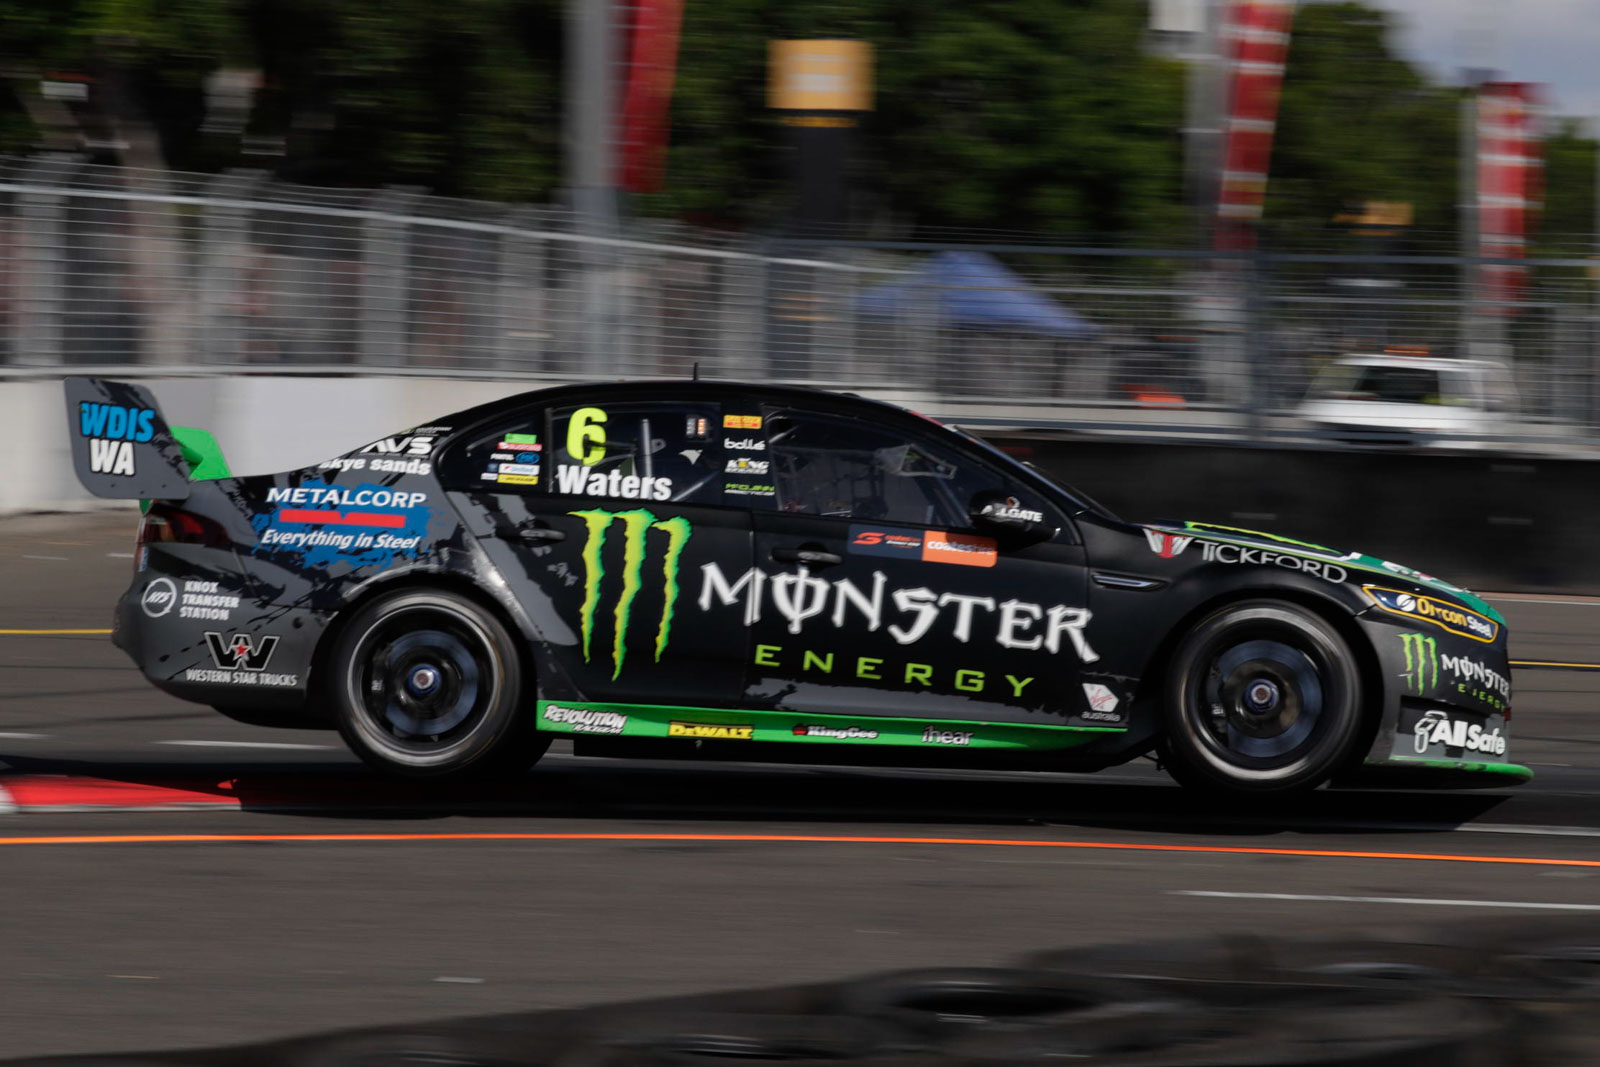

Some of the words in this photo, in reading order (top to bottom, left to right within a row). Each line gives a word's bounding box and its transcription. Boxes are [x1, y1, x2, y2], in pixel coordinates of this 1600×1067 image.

[80, 403, 154, 442] WDIS
[566, 407, 608, 466] 6
[90, 439, 135, 475] WA
[369, 458, 432, 475] sands
[557, 464, 672, 501] Waters
[265, 487, 427, 509] METALCORP
[261, 529, 354, 549] Everything
[354, 533, 372, 548] in
[372, 535, 421, 549] Steel
[1194, 539, 1348, 584] TICKFORD
[184, 580, 219, 593] KNOX
[179, 606, 230, 620] STATION
[182, 594, 240, 608] TRANSFER
[698, 561, 1100, 664] MONSTER
[186, 669, 231, 683] WESTERN
[232, 671, 257, 684] STAR
[259, 673, 298, 686] TRUCKS
[754, 644, 1035, 697] ENERGY
[543, 704, 628, 729] REVOLUTION
